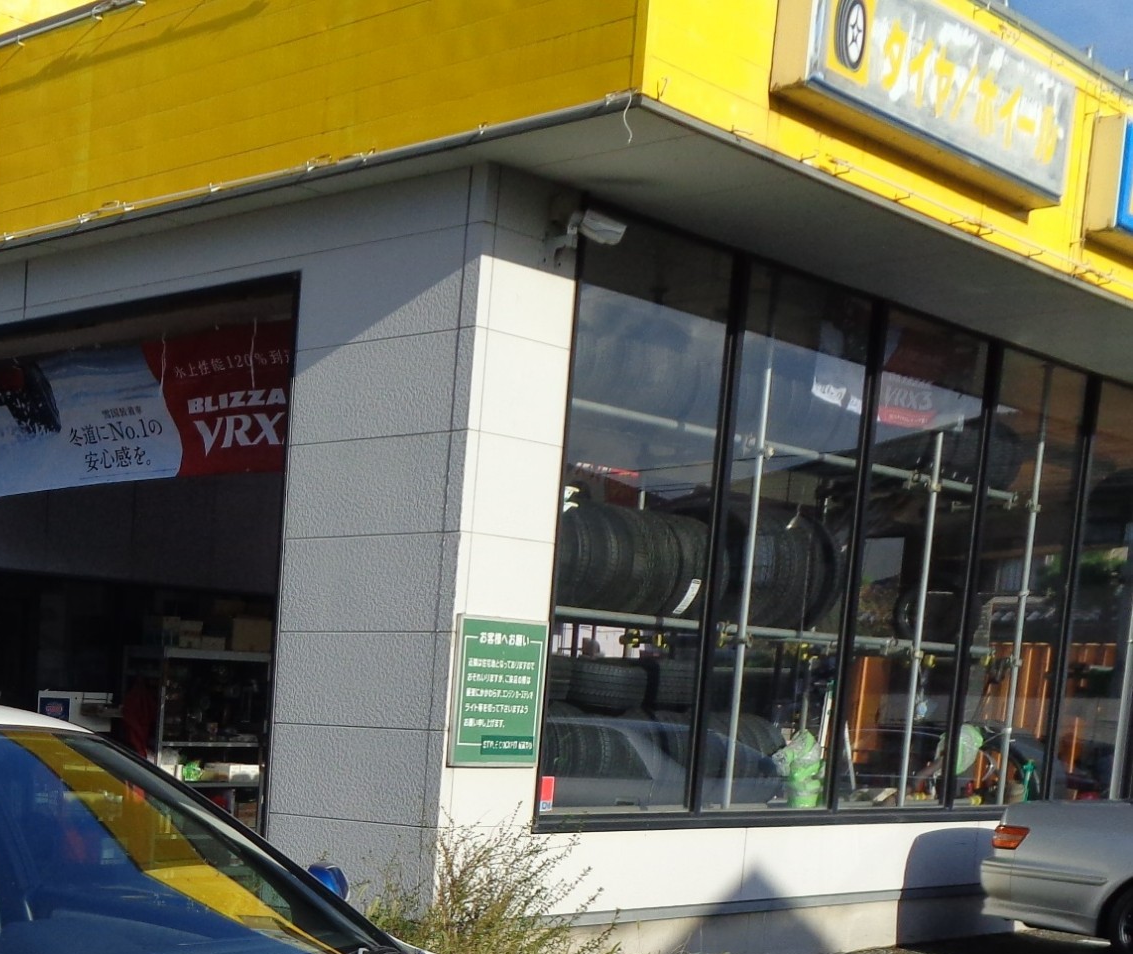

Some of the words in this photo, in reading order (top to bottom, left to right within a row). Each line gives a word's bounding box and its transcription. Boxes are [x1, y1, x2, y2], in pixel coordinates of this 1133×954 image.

[70, 418, 163, 448] 冬道にNo.1の
[193, 411, 286, 457] VRX
[85, 446, 151, 473] 安心感を。
